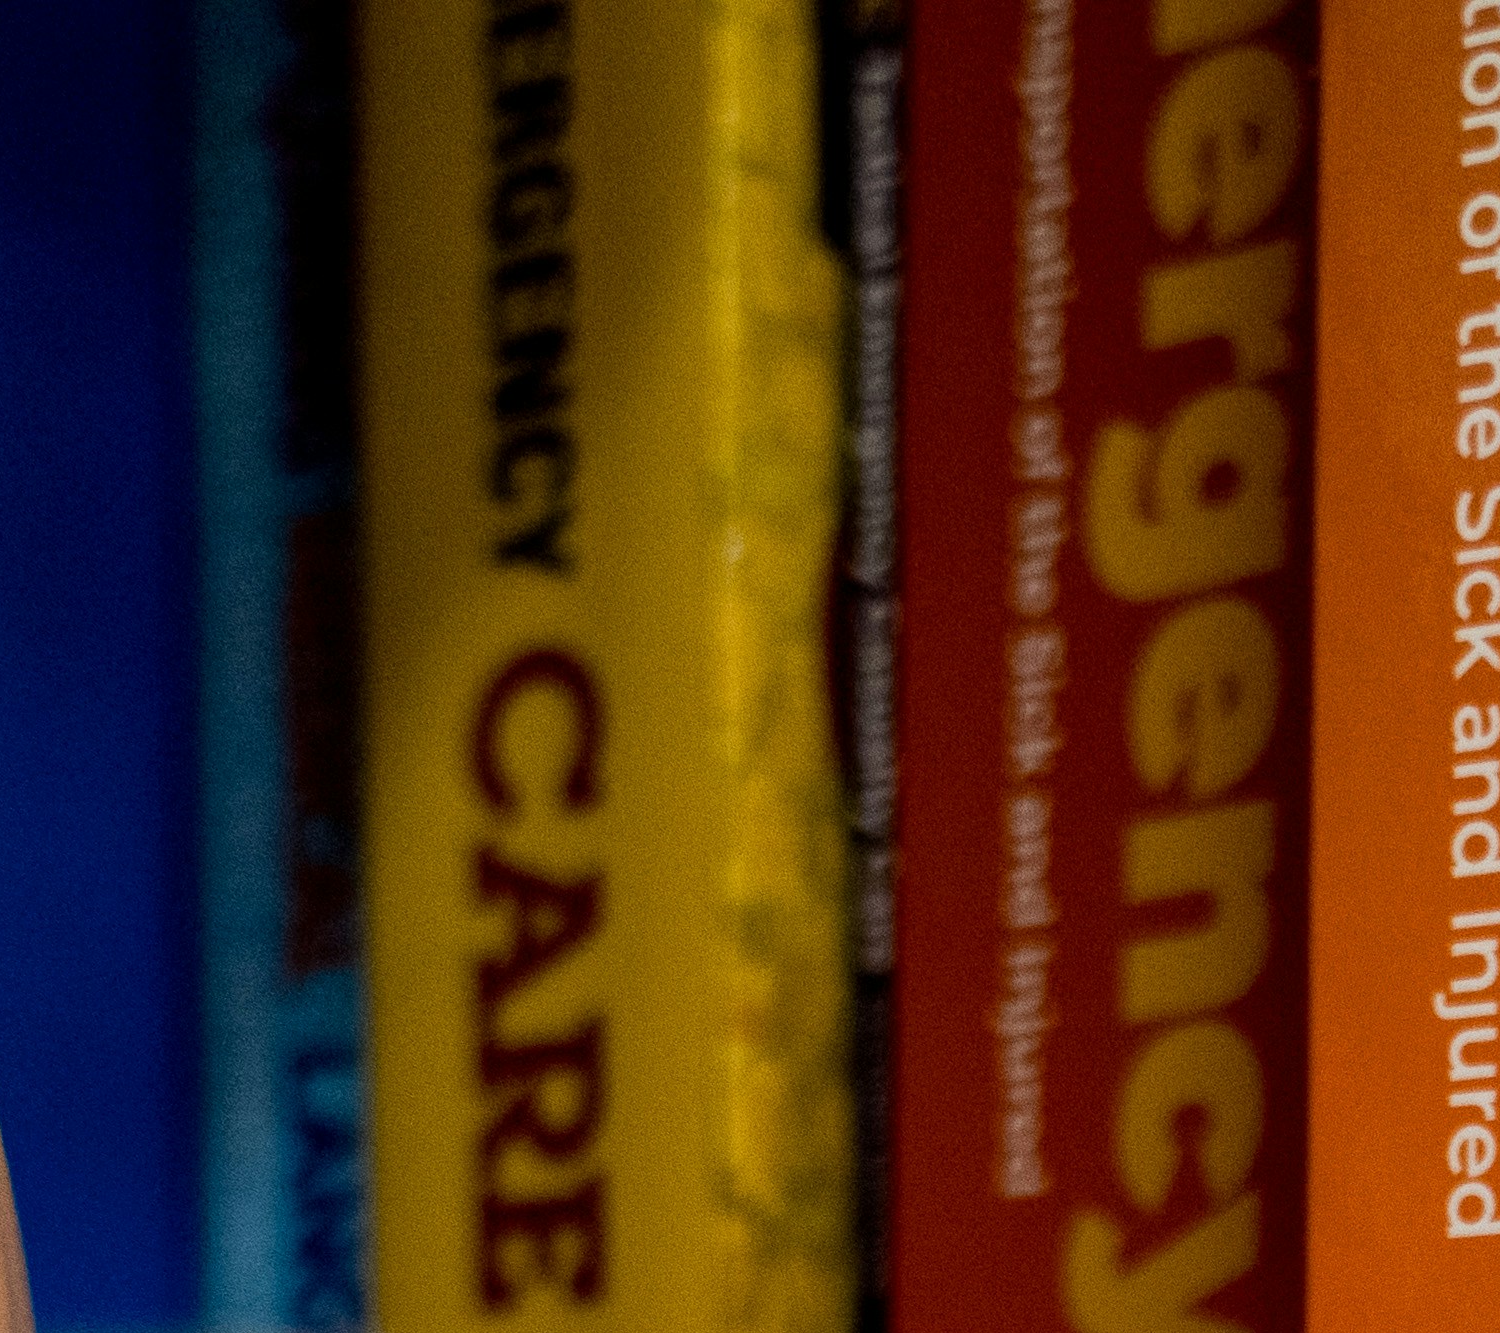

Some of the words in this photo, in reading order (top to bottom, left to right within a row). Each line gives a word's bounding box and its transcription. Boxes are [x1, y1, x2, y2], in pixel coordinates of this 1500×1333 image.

[1018, 413, 1070, 480] of
[1016, 498, 1064, 612] the
[1010, 633, 1062, 775] Sick
[1006, 795, 1056, 928] and
[470, 645, 606, 1312] CARE
[996, 945, 1051, 1198] Injured
